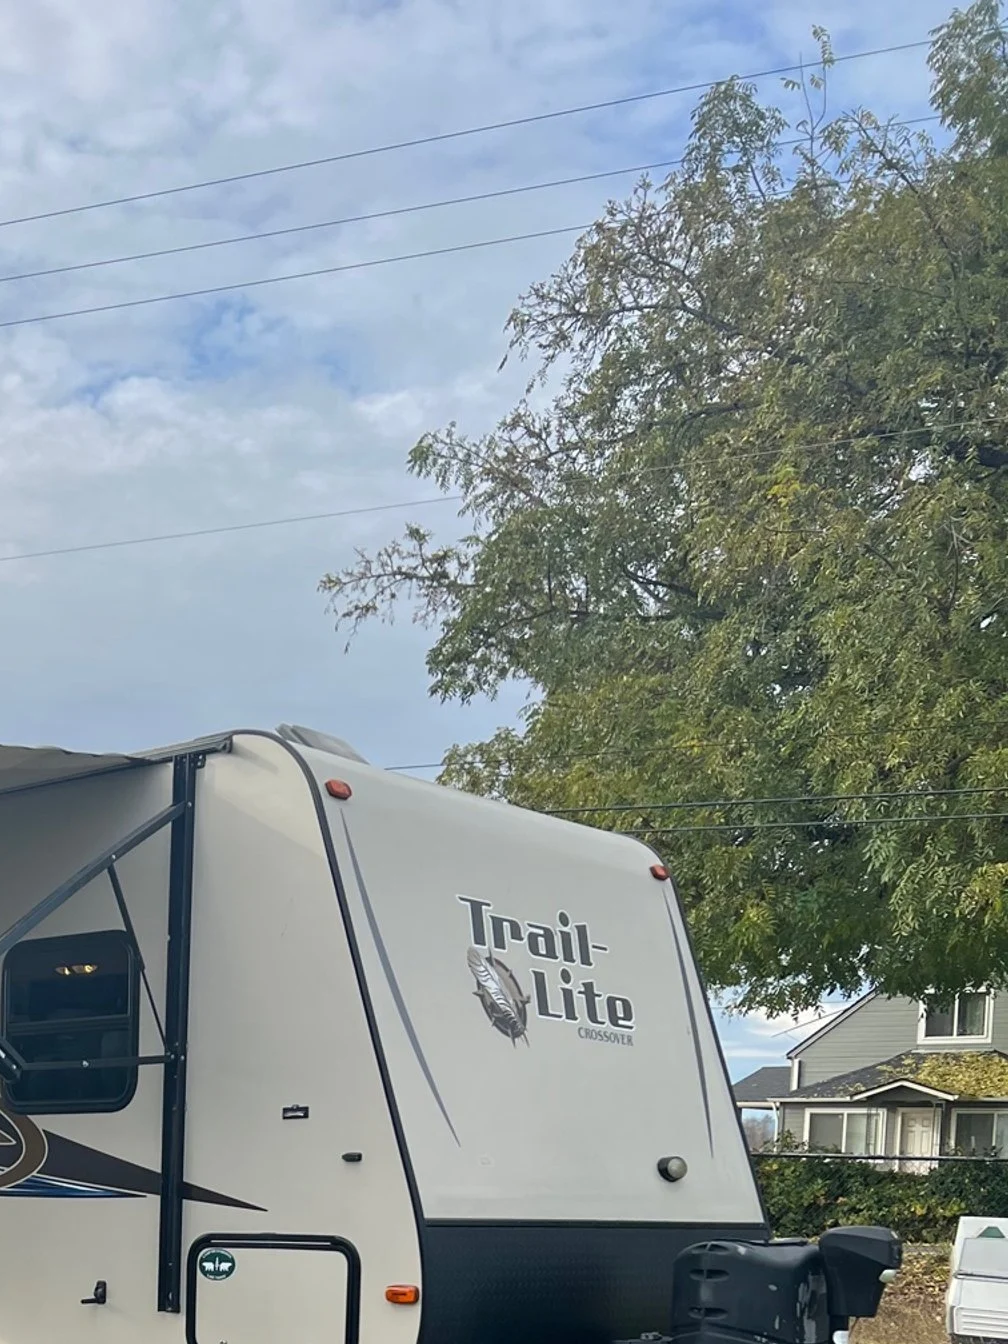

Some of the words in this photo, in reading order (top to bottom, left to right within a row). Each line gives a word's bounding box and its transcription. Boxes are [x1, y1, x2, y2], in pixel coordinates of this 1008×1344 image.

[457, 895, 608, 966] Trail-
[531, 967, 635, 1030] Lite
[578, 1026, 634, 1046] CROSSOVER
